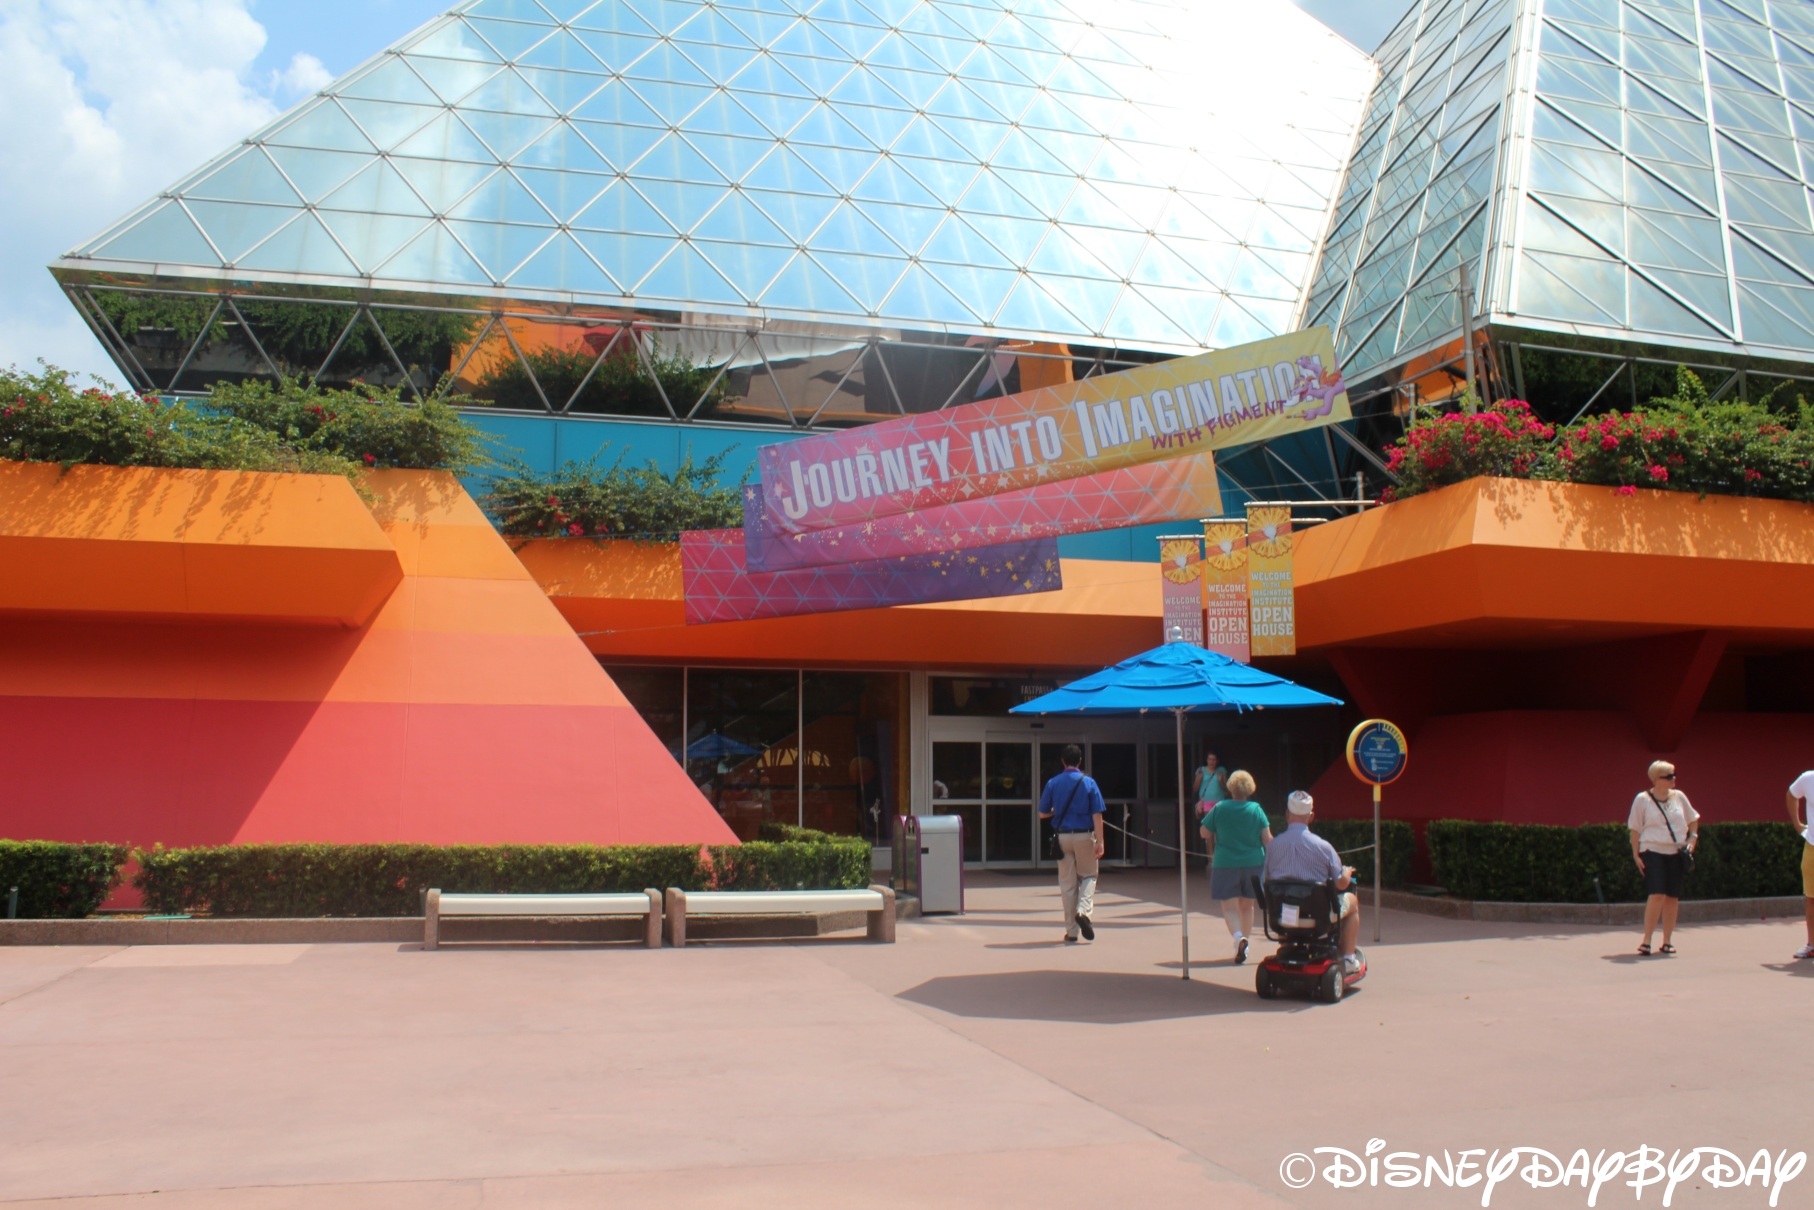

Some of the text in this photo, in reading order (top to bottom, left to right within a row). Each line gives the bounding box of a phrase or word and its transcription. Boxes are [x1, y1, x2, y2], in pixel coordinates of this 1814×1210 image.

[1151, 399, 1288, 450] WITH FIGMENT
[782, 436, 951, 520] JOURNEY
[969, 414, 1063, 476] INTO
[1251, 571, 1292, 581] WELCOME
[1208, 584, 1246, 593] WELCOME
[1251, 589, 1292, 597] IMAGINATION
[1164, 596, 1201, 605] WELCOME
[1252, 596, 1293, 606] INSTITUTE
[1209, 607, 1248, 616] INSTITUTE
[1252, 606, 1292, 623] OPEN
[1165, 619, 1202, 627] INSTITUTE
[1209, 617, 1247, 632] OPEN
[1165, 627, 1202, 642] OEN
[1252, 622, 1293, 636] HOUSE
[1209, 632, 1248, 645] HOUSE
